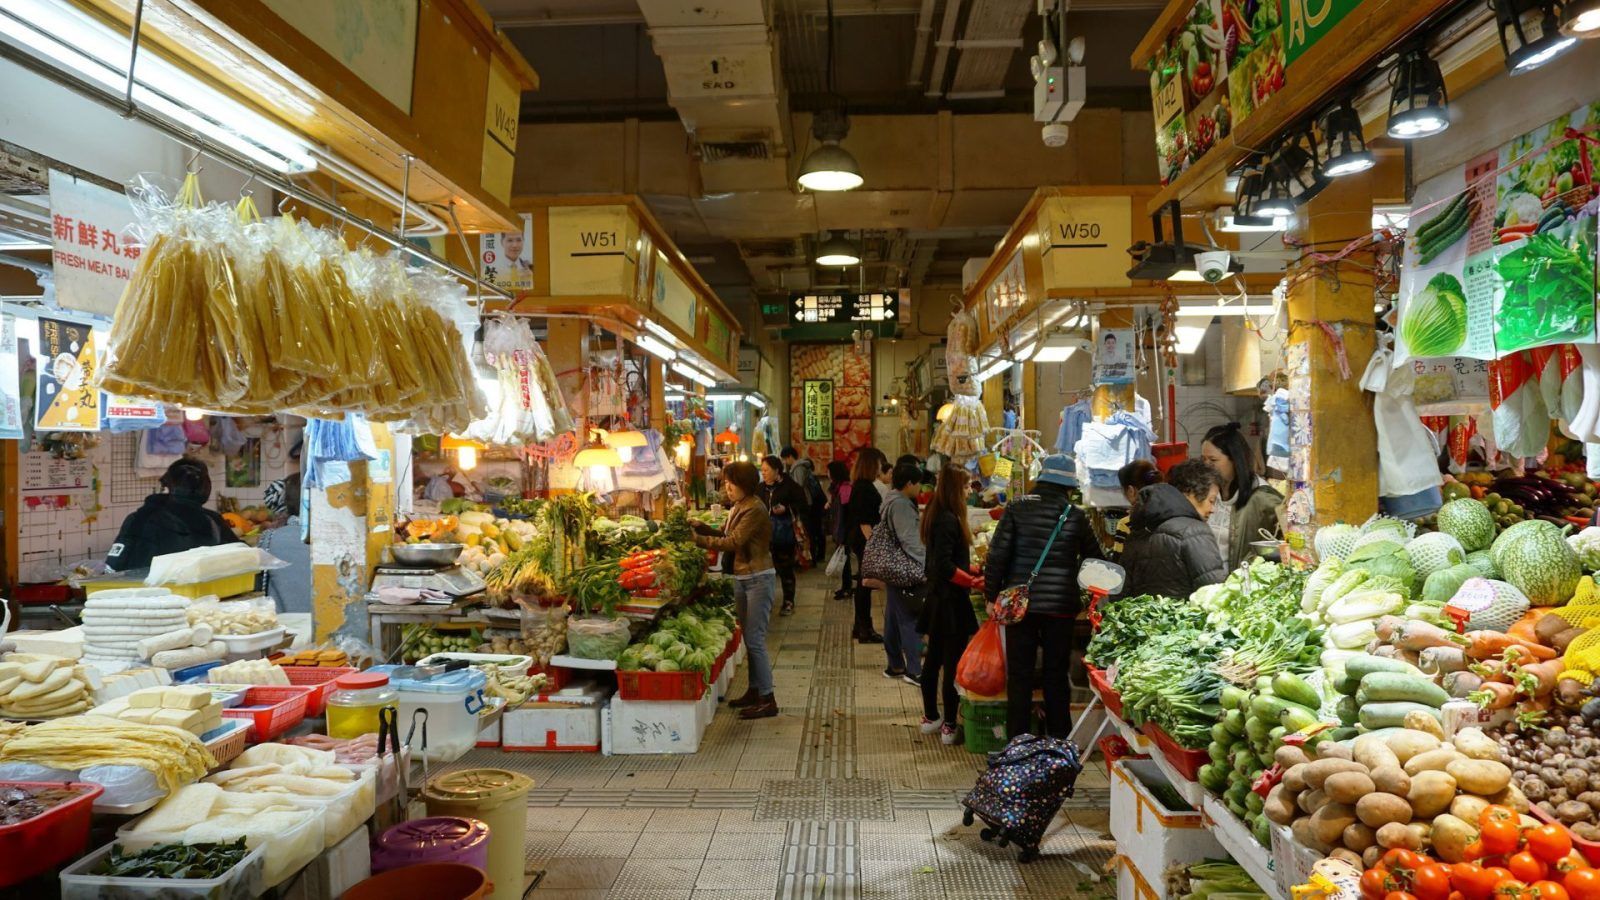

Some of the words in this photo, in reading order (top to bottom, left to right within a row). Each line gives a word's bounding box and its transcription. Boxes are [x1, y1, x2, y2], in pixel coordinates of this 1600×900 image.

[1154, 81, 1176, 119] W42
[495, 102, 516, 140] W43
[580, 231, 616, 247] W51
[1059, 223, 1101, 239] W50
[54, 250, 86, 271] FRESH
[87, 259, 114, 277] MEAT
